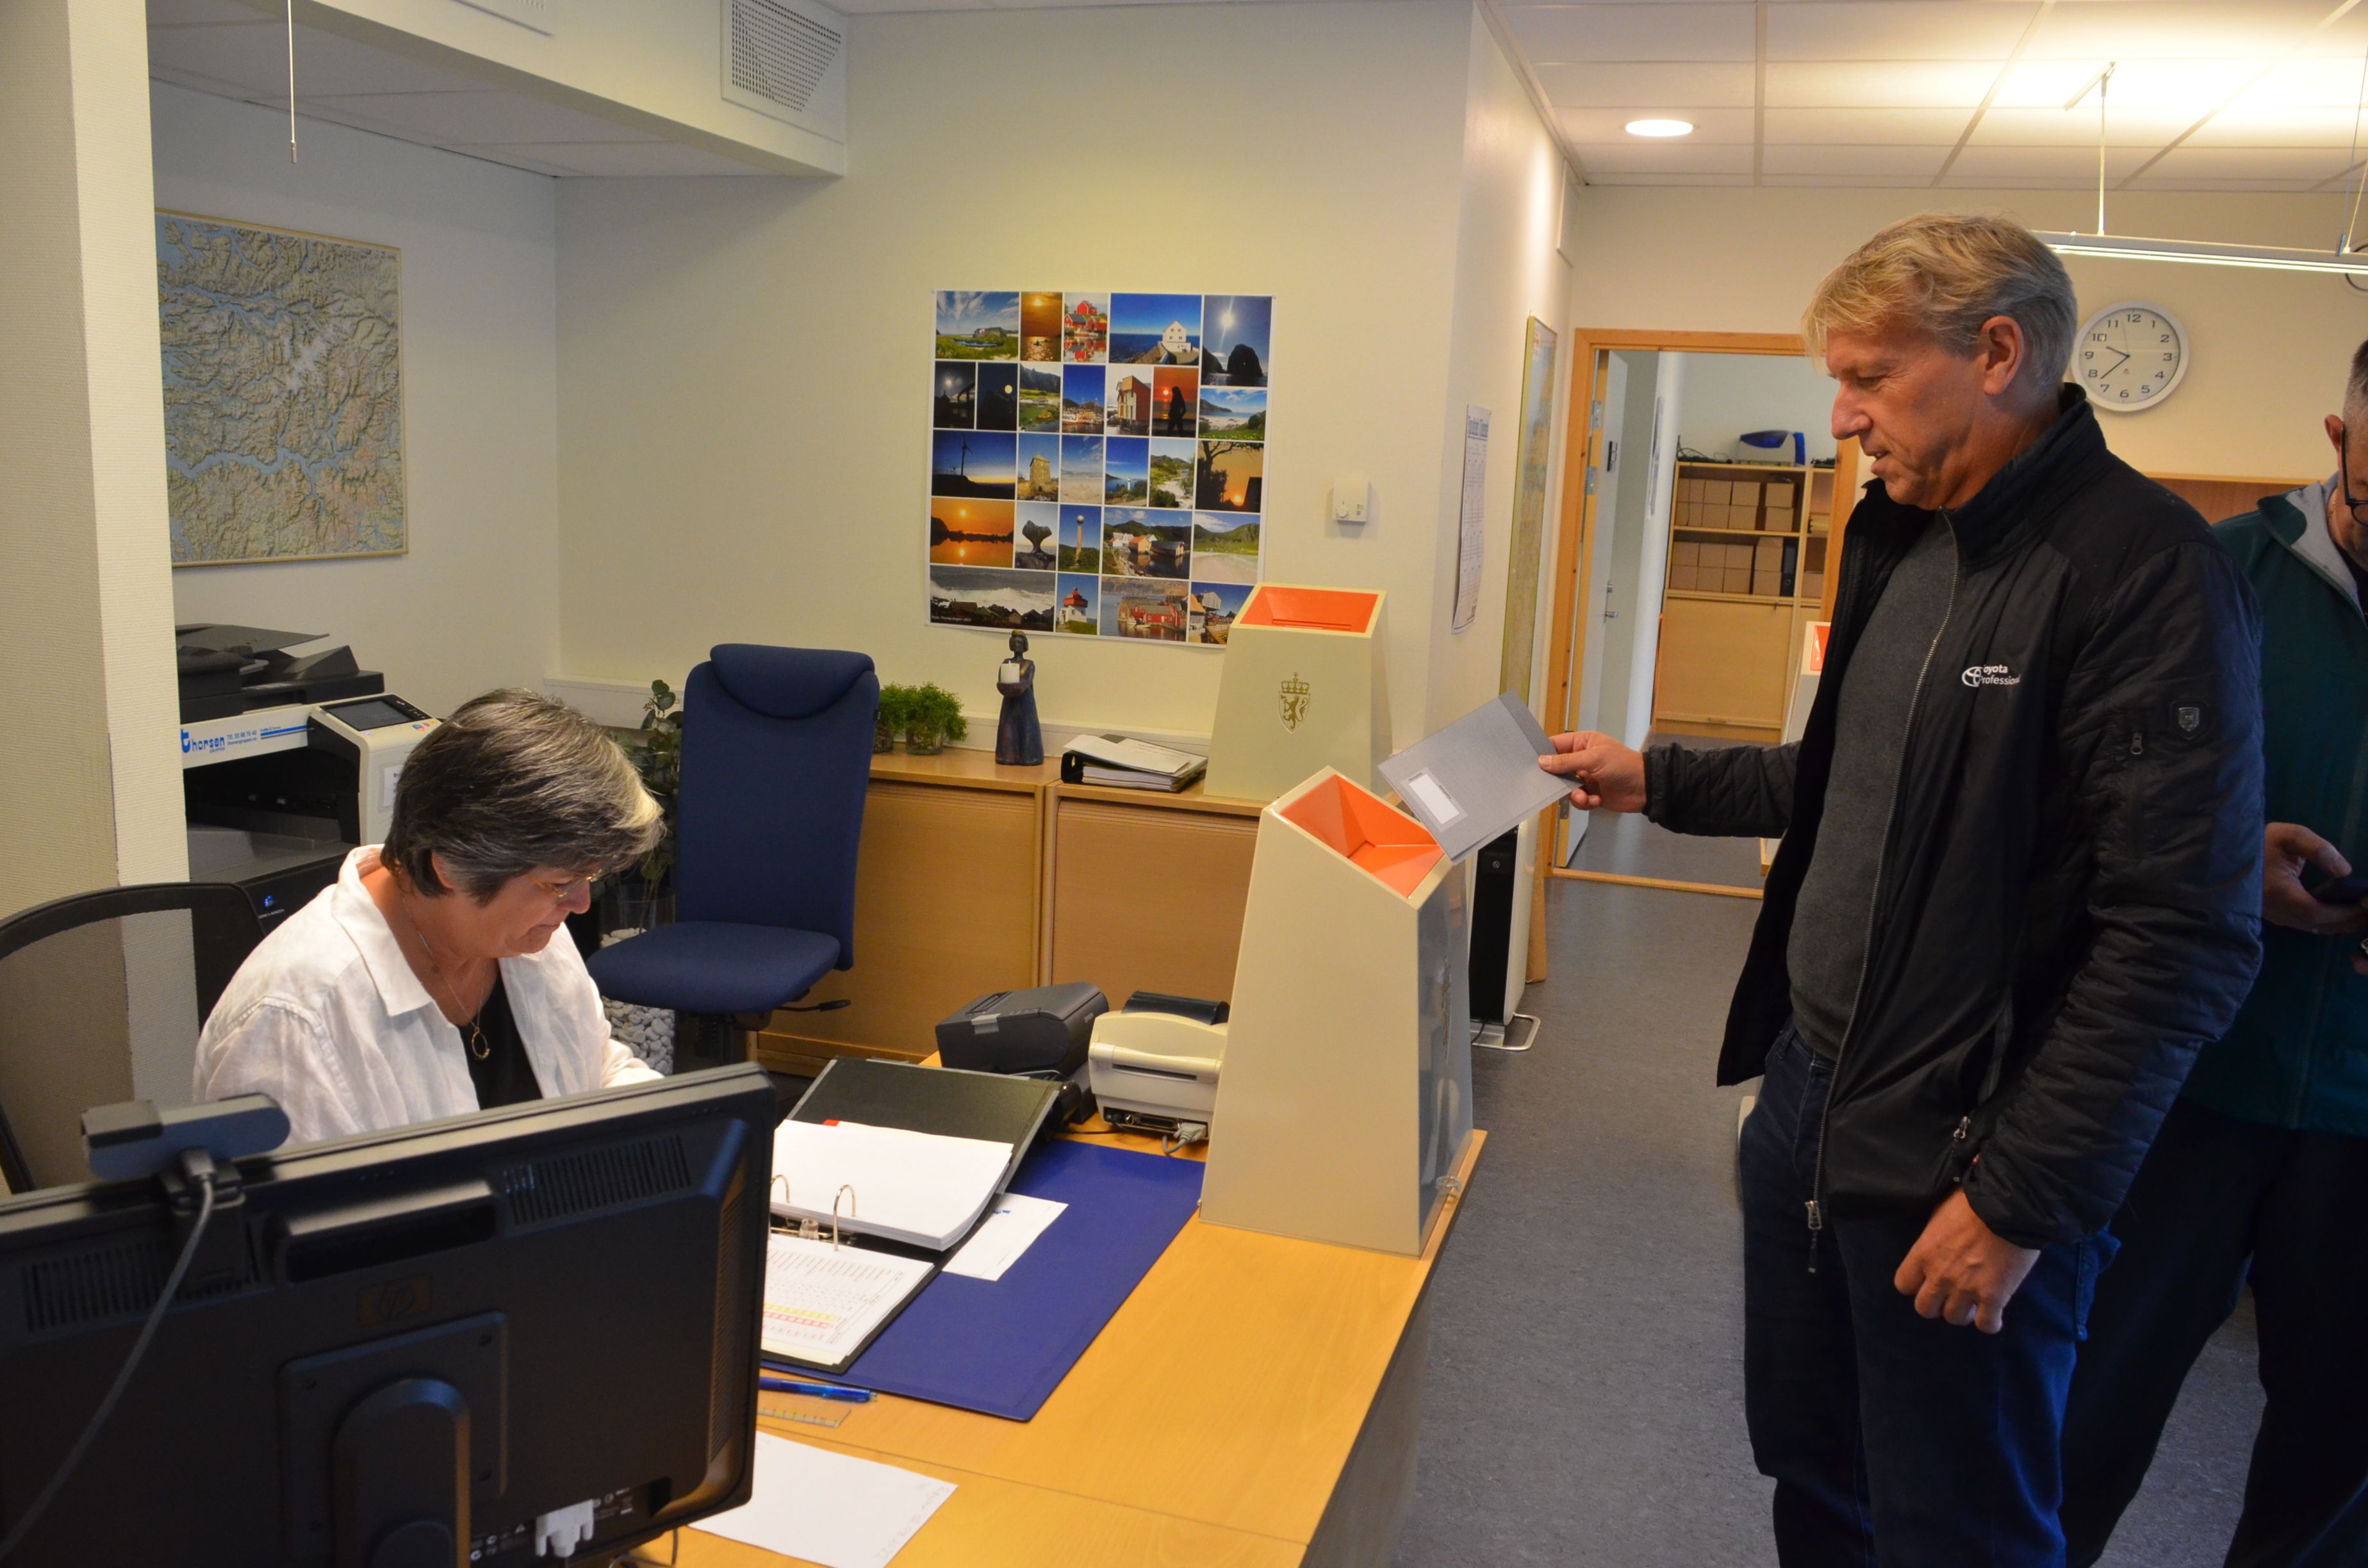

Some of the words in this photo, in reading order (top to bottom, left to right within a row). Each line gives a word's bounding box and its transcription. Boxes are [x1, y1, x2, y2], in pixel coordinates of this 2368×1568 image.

[2126, 314, 2141, 322] 12
[2107, 320, 2118, 328] 11
[2151, 320, 2155, 328] 1
[2092, 333, 2107, 341] 10
[2160, 334, 2169, 343] 2
[2084, 351, 2094, 359] 9
[2163, 353, 2172, 361] 3
[2088, 369, 2098, 378] 8
[2154, 371, 2164, 379] 4
[2100, 384, 2110, 393] 7
[2141, 385, 2150, 393] 5
[2119, 389, 2129, 398] 6
